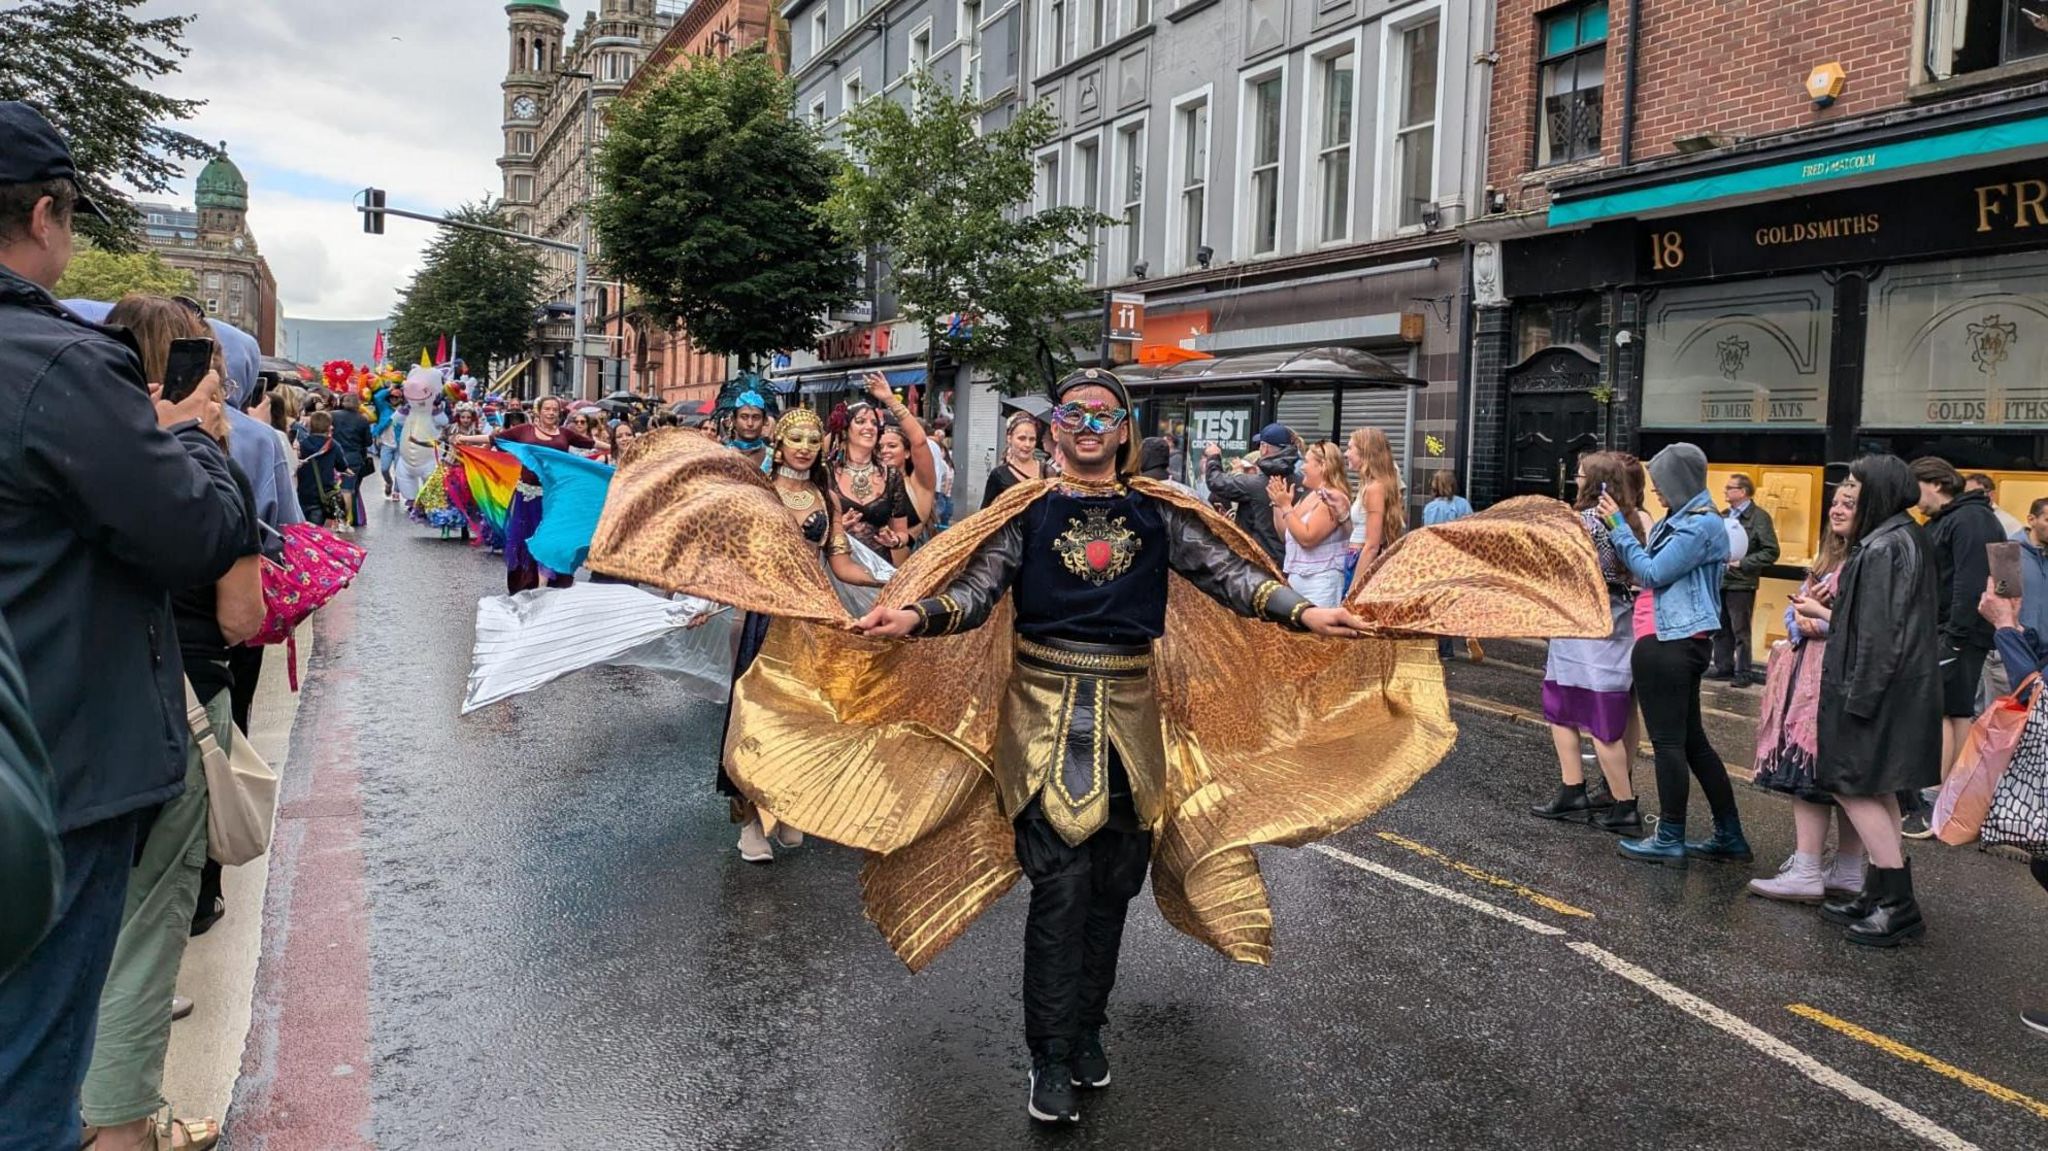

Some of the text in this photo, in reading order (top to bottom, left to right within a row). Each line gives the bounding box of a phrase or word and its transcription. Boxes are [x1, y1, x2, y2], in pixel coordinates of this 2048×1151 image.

[1802, 163, 1825, 178] FRED
[1974, 180, 2048, 232] FR
[1756, 214, 1879, 245] GOLDSMITHS
[1651, 231, 1684, 270] 18
[1118, 308, 1135, 329] 11
[1725, 402, 1804, 418] MERANTS
[1927, 401, 2048, 421] GOLDSITHS
[1193, 410, 1249, 440] TEST
